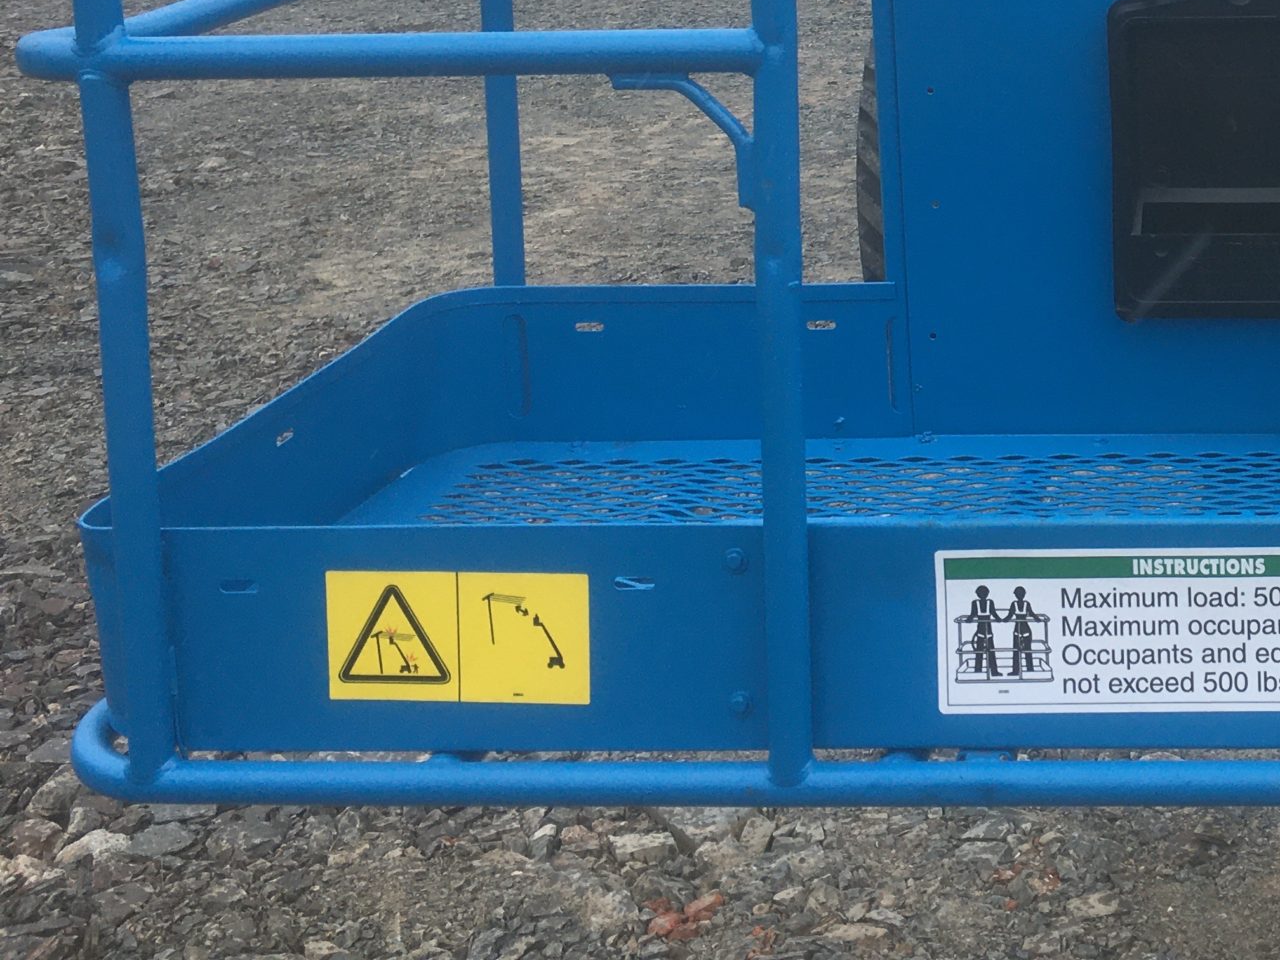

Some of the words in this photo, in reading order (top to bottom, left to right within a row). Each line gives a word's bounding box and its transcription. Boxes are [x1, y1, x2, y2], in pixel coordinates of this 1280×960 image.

[1132, 558, 1266, 575] INSTRUCTIONS
[1061, 587, 1178, 609] Maximum
[1188, 586, 1246, 608] load:
[1061, 615, 1179, 637] Maximum
[1061, 643, 1193, 670] Occupants
[1201, 642, 1247, 664] and
[1062, 673, 1101, 694] not
[1108, 671, 1195, 694] exceed
[1203, 671, 1249, 693] 500
